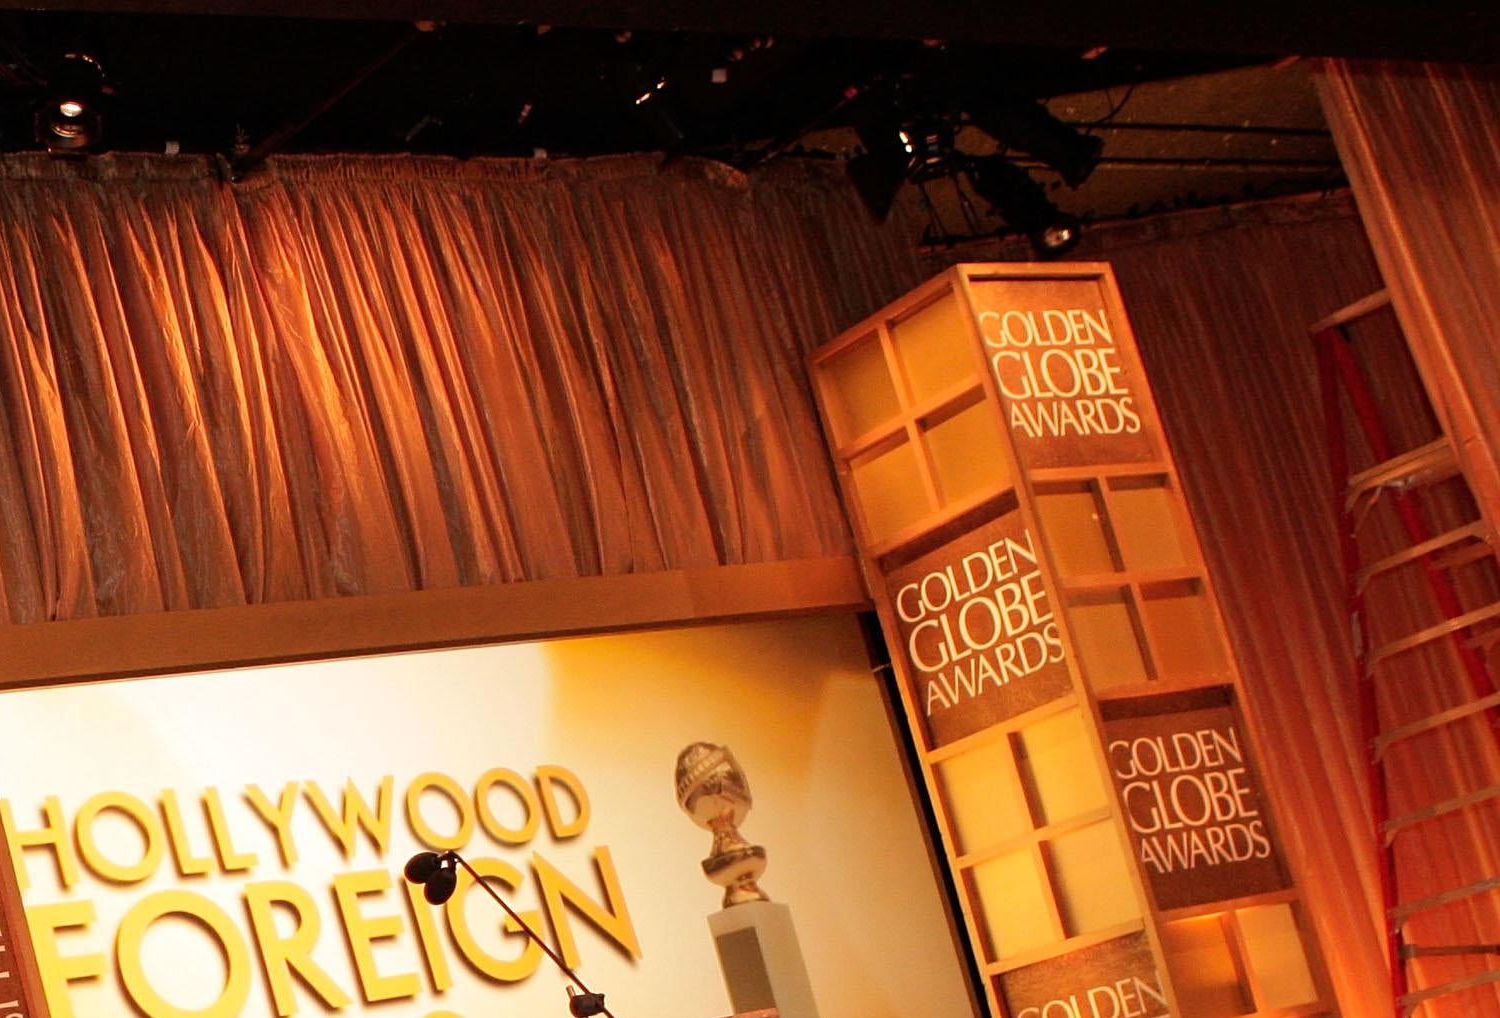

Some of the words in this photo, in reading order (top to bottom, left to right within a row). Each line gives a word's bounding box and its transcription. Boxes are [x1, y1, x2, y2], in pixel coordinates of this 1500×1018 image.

[979, 309, 1113, 348] GOLDEN
[992, 348, 1129, 400] GLOBE
[1011, 397, 1141, 438] AWARDS
[897, 529, 1038, 623] GOLDEN
[909, 570, 1053, 673] GLOBE
[927, 622, 1065, 717] AWARDS
[1109, 727, 1243, 779] GOLDEN
[0, 764, 591, 888] HOLLYWOOD
[1123, 768, 1259, 833] GLOBE
[1141, 820, 1271, 874] AWARDS
